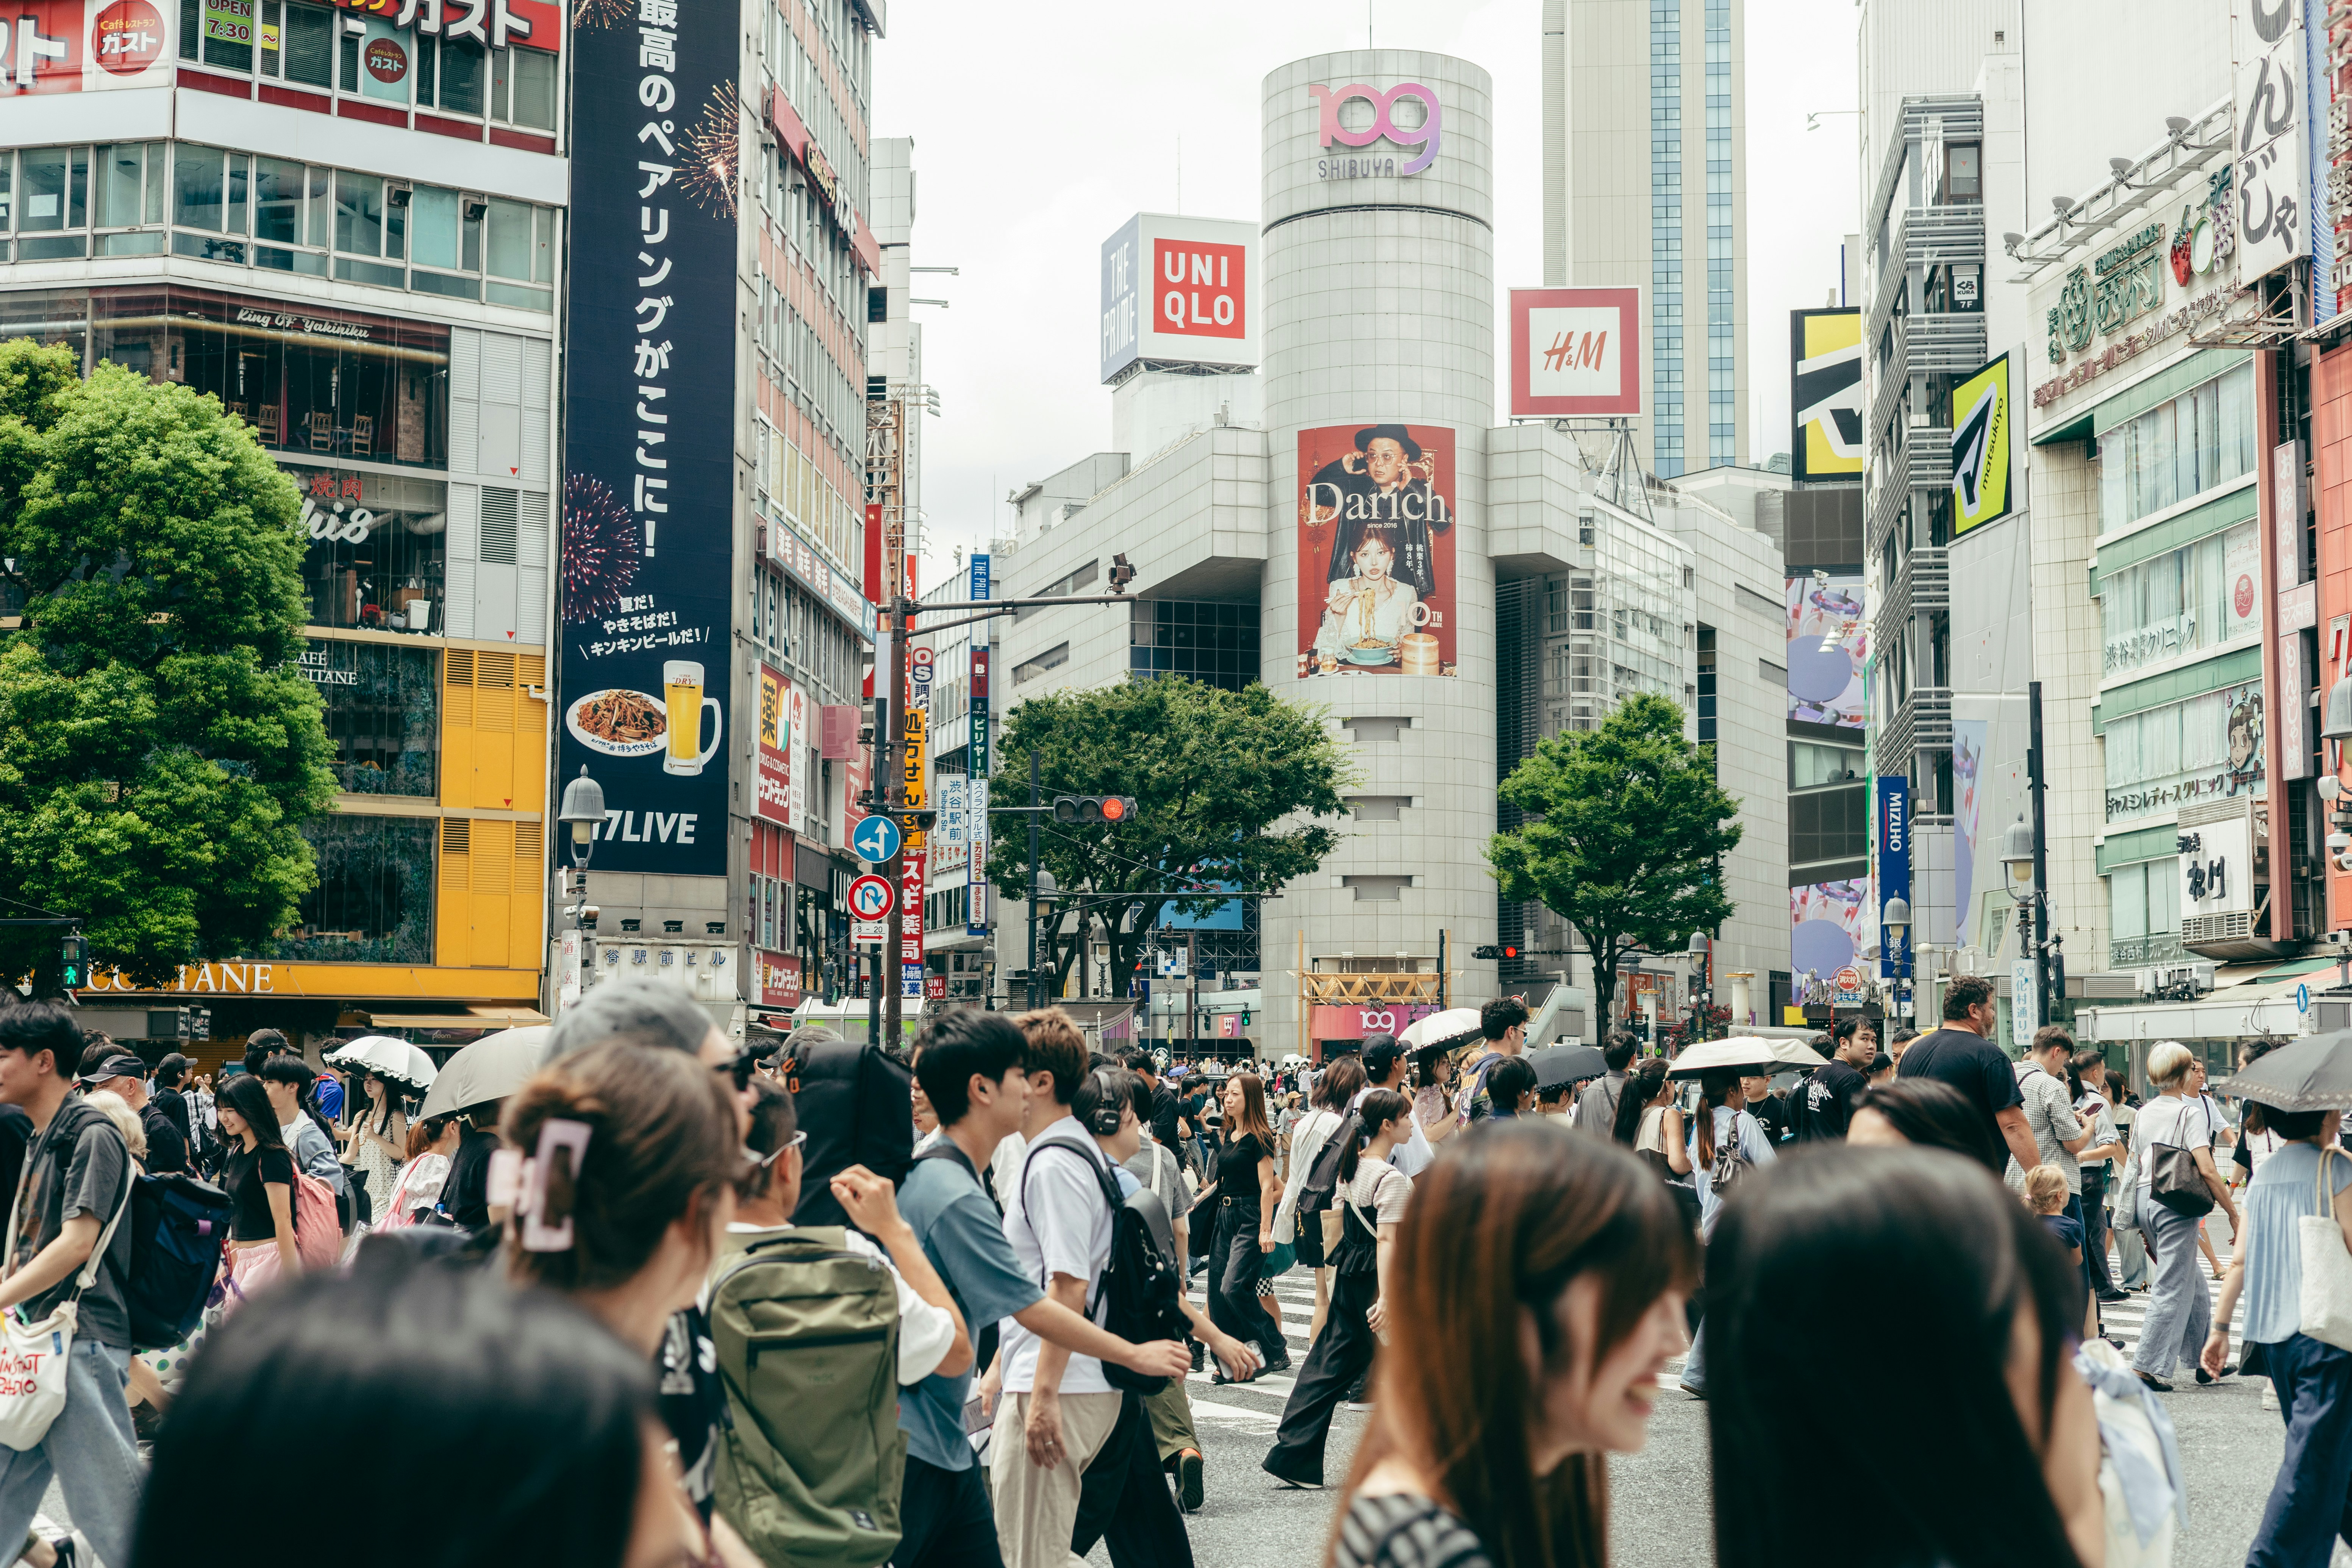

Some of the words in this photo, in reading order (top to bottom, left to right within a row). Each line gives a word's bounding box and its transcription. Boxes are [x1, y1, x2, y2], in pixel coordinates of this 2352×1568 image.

[100, 18, 124, 30] Café
[125, 18, 155, 28] レストラン
[207, 0, 251, 18] OPEN
[100, 32, 157, 55] ガスト
[206, 18, 250, 41] 7:30
[370, 47, 384, 56] Café
[370, 56, 403, 72] ガスト
[1309, 82, 1442, 176] 109
[1318, 158, 1394, 180] SHIBUYA
[2095, 247, 2120, 275] FRUITS
[2127, 224, 2159, 255] PARLOR
[634, 0, 678, 557] 最高のペアリングがここに！
[1110, 241, 1129, 302] THE
[1164, 251, 1228, 287] UNI
[237, 308, 270, 327] King
[302, 318, 369, 338] Yakiniku
[1164, 291, 1235, 328] QLO
[1103, 291, 1135, 363] PRIME
[1544, 331, 1607, 372] H&M
[1983, 397, 2004, 491] matsukiyo
[310, 472, 363, 501] 焼肉
[1305, 481, 1448, 525] Darich
[2280, 453, 2294, 580] お好み焼
[777, 526, 792, 564] 薄毛
[1405, 543, 1414, 572] 柿8年。
[2227, 537, 2259, 558] レーザー脱毛
[797, 543, 811, 580] 抜毛
[815, 559, 828, 596] 発毛
[974, 561, 986, 575] THE
[1416, 544, 1425, 580] 桃栗3年、
[619, 594, 654, 613] 夏だ！
[974, 578, 986, 601] PRIM
[2282, 594, 2292, 606] 渋谷
[603, 611, 678, 635] やきそばだ！
[865, 604, 875, 638] 4F
[1401, 601, 1431, 627] 10
[1432, 610, 1442, 622] TH
[590, 628, 701, 657] キンキンビールだ！
[2106, 640, 2129, 670] 渋谷
[2130, 647, 2146, 663] 外科
[2147, 618, 2196, 657] クリニック
[2228, 625, 2238, 637] 渋谷
[293, 650, 327, 666] AFÉ
[914, 649, 932, 681] OS
[763, 681, 775, 741] 薬
[2285, 640, 2299, 771] もんじゃ焼
[617, 740, 658, 752] 博多やきそば
[974, 719, 985, 780] ビリヤード
[760, 752, 769, 767] DRUG
[770, 757, 773, 769] &
[773, 757, 789, 777] COSMETIC
[759, 773, 789, 808] サンドラッグ
[2107, 774, 2224, 814] ジャスミンレディースクリニック
[949, 780, 962, 841] 渋谷駅前
[973, 782, 984, 839] スクランブル式
[1889, 792, 1902, 852] MIZUHO
[902, 861, 921, 960] スギ薬局
[2112, 944, 2144, 961] 渋谷西村
[774, 967, 799, 991] サンドラッグ
[1839, 975, 1857, 984] 消火栓
[2015, 966, 2028, 1031] 文化村通り
[433, 1029, 451, 1043] ploom
[1360, 1011, 1396, 1035] 109
